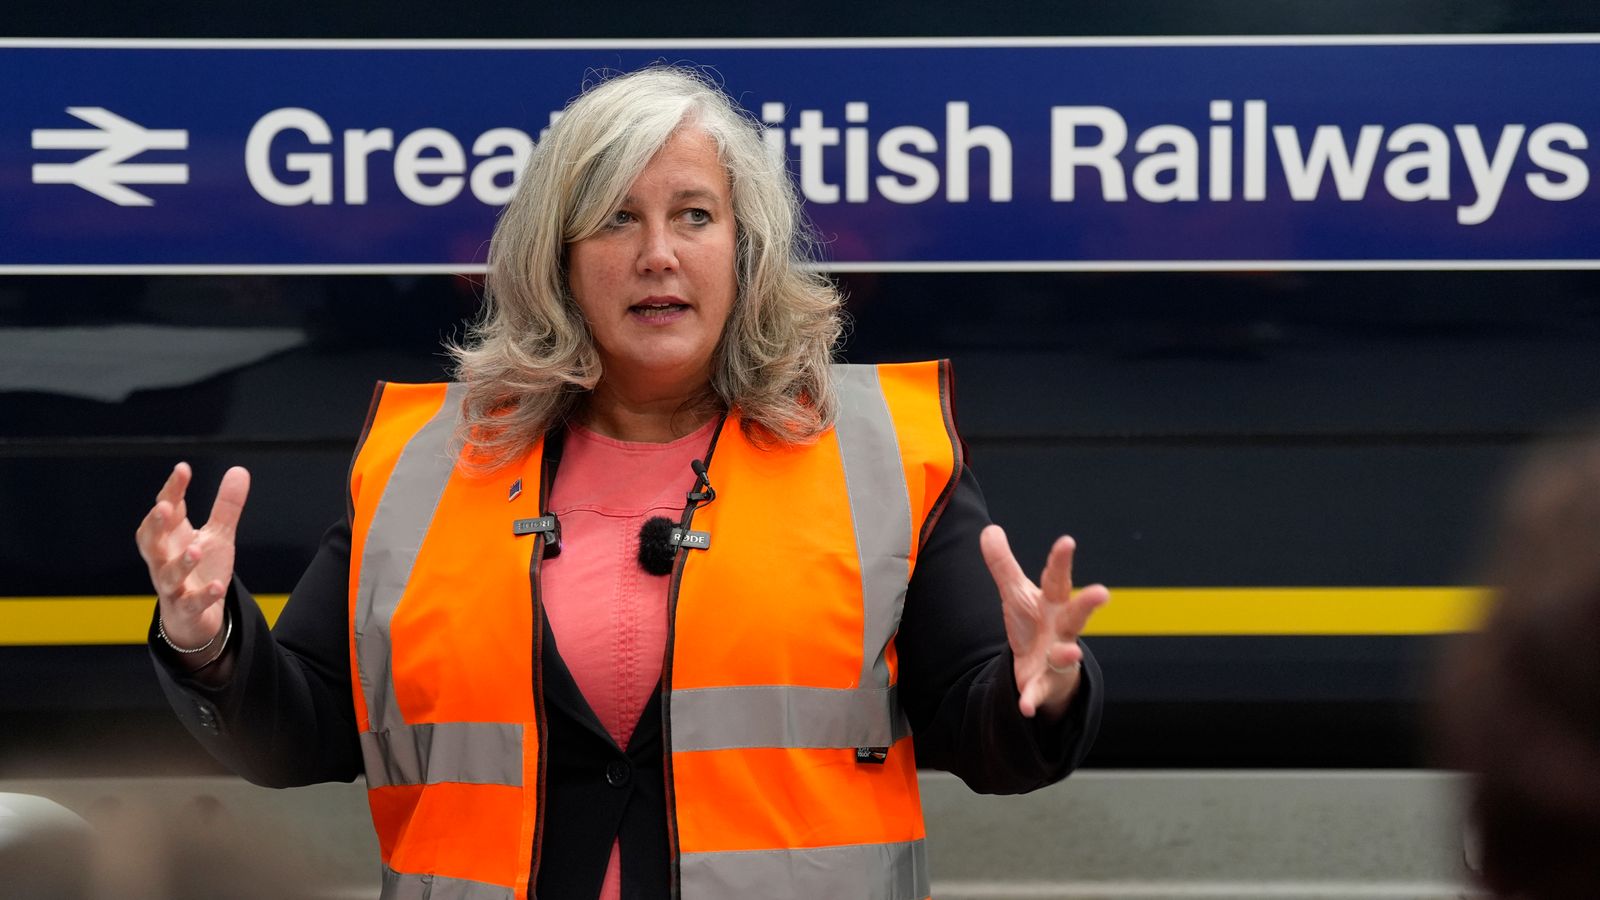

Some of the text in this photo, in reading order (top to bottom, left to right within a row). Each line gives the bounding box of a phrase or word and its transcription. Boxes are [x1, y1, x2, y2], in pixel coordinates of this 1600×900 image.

[244, 99, 1590, 226] Grea itish Railways
